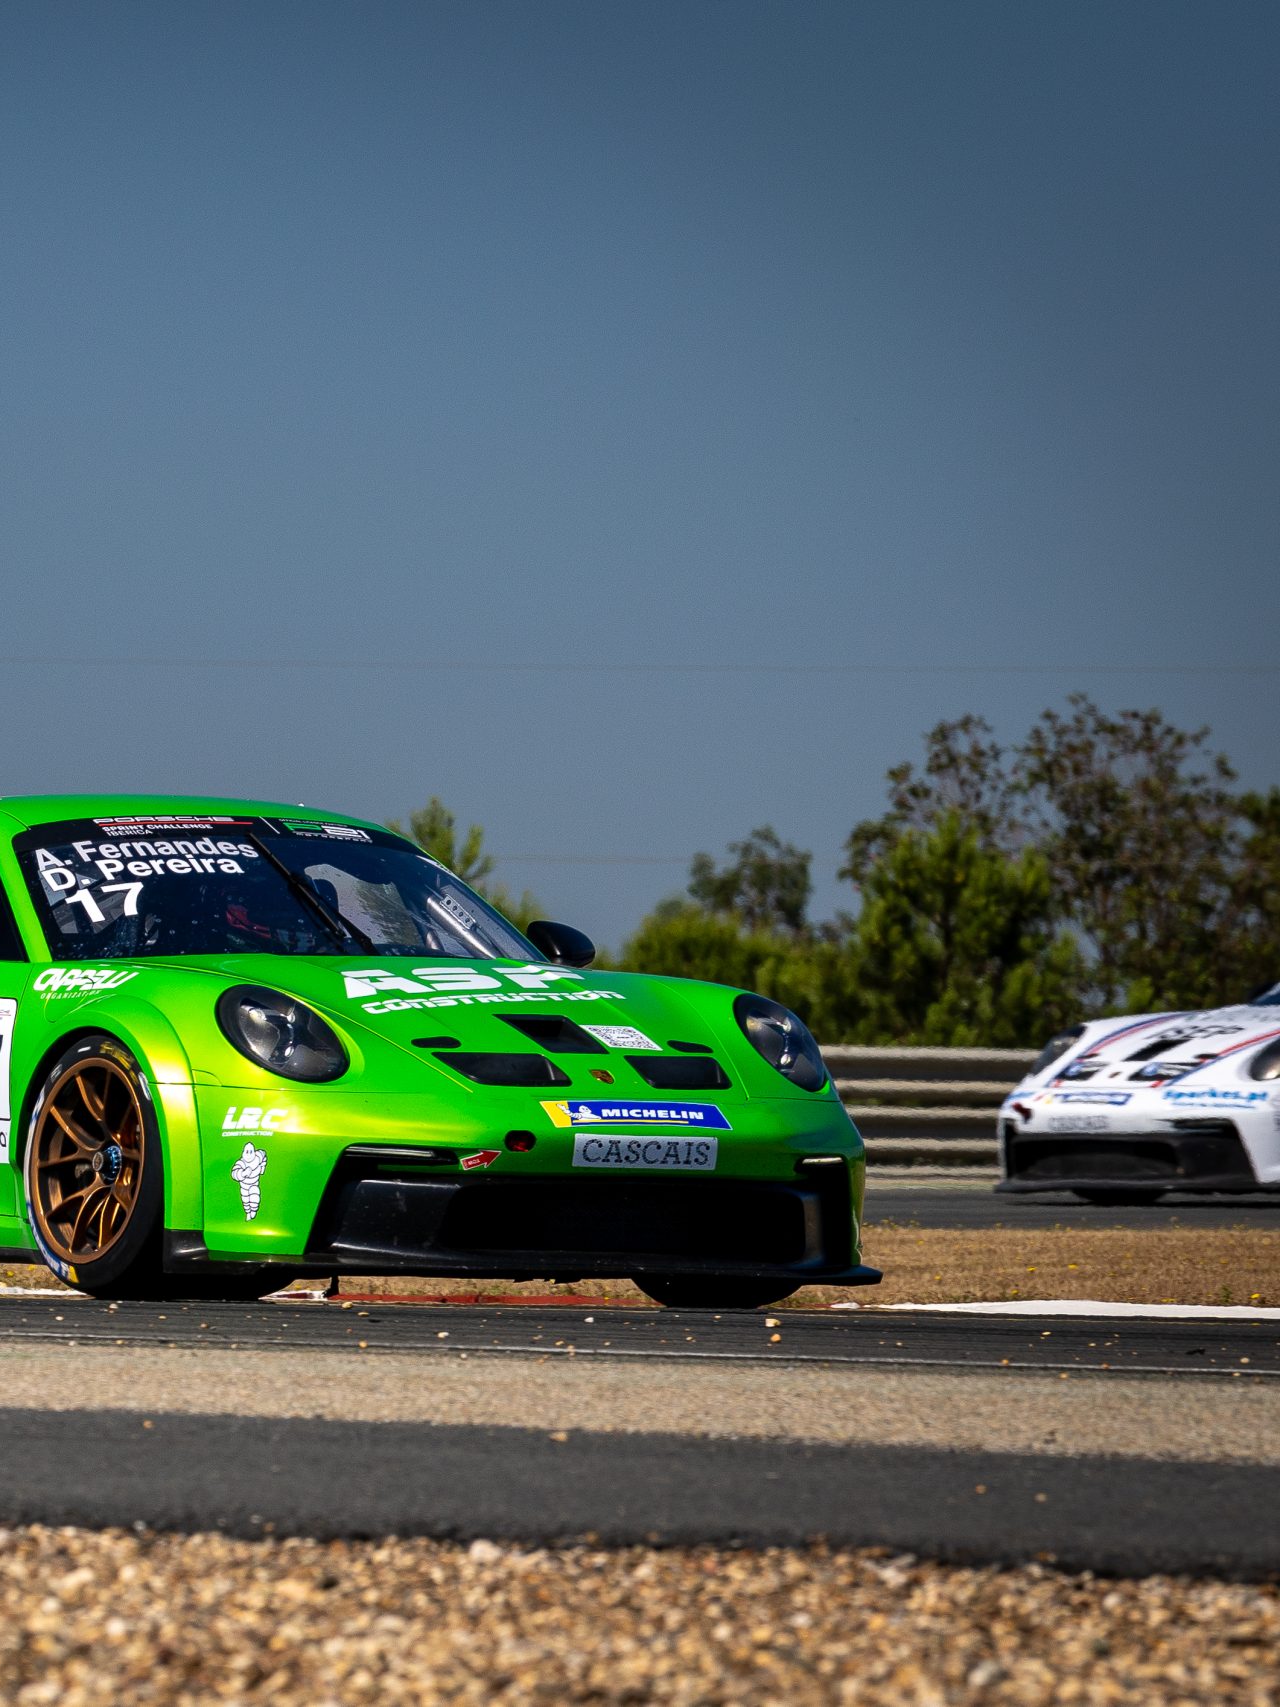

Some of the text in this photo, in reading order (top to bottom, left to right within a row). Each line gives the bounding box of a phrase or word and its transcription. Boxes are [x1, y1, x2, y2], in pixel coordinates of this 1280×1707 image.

[93, 816, 235, 824] PORSCHE
[102, 824, 145, 832] SPRINT
[107, 829, 154, 837] IBERICA
[35, 837, 259, 871] A. Fernandes
[42, 854, 245, 892] D. Pereira
[65, 881, 144, 923] 17
[341, 965, 584, 999] ASF
[40, 990, 102, 1000] ORGANIZATION
[361, 990, 627, 1014] CONSTRUCTION
[222, 1106, 289, 1129] LRC
[602, 1107, 704, 1120] MICHELIN
[582, 1138, 712, 1166] CASCAIS
